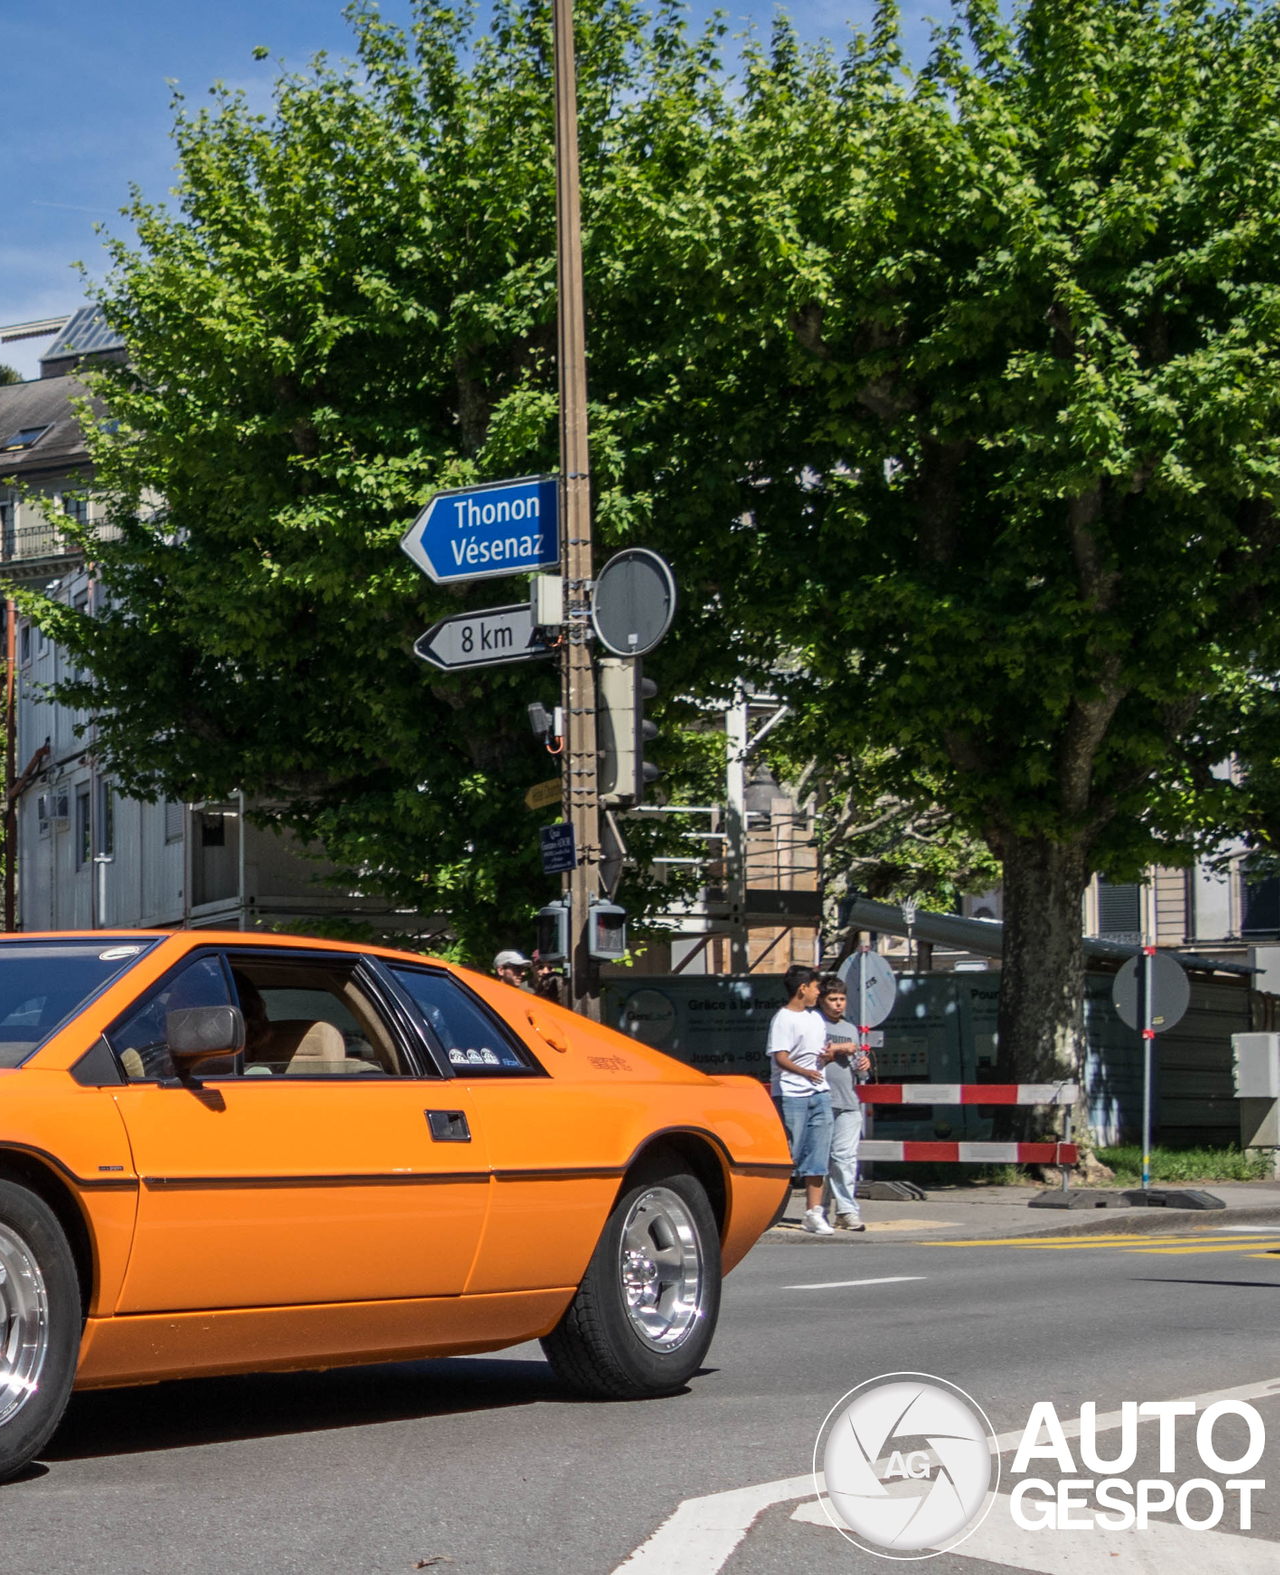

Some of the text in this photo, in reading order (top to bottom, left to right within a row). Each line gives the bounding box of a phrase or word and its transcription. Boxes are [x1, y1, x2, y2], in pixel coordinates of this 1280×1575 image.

[454, 496, 540, 529] Thonon
[451, 533, 545, 566] Vésenaz
[461, 622, 513, 653] 8 km
